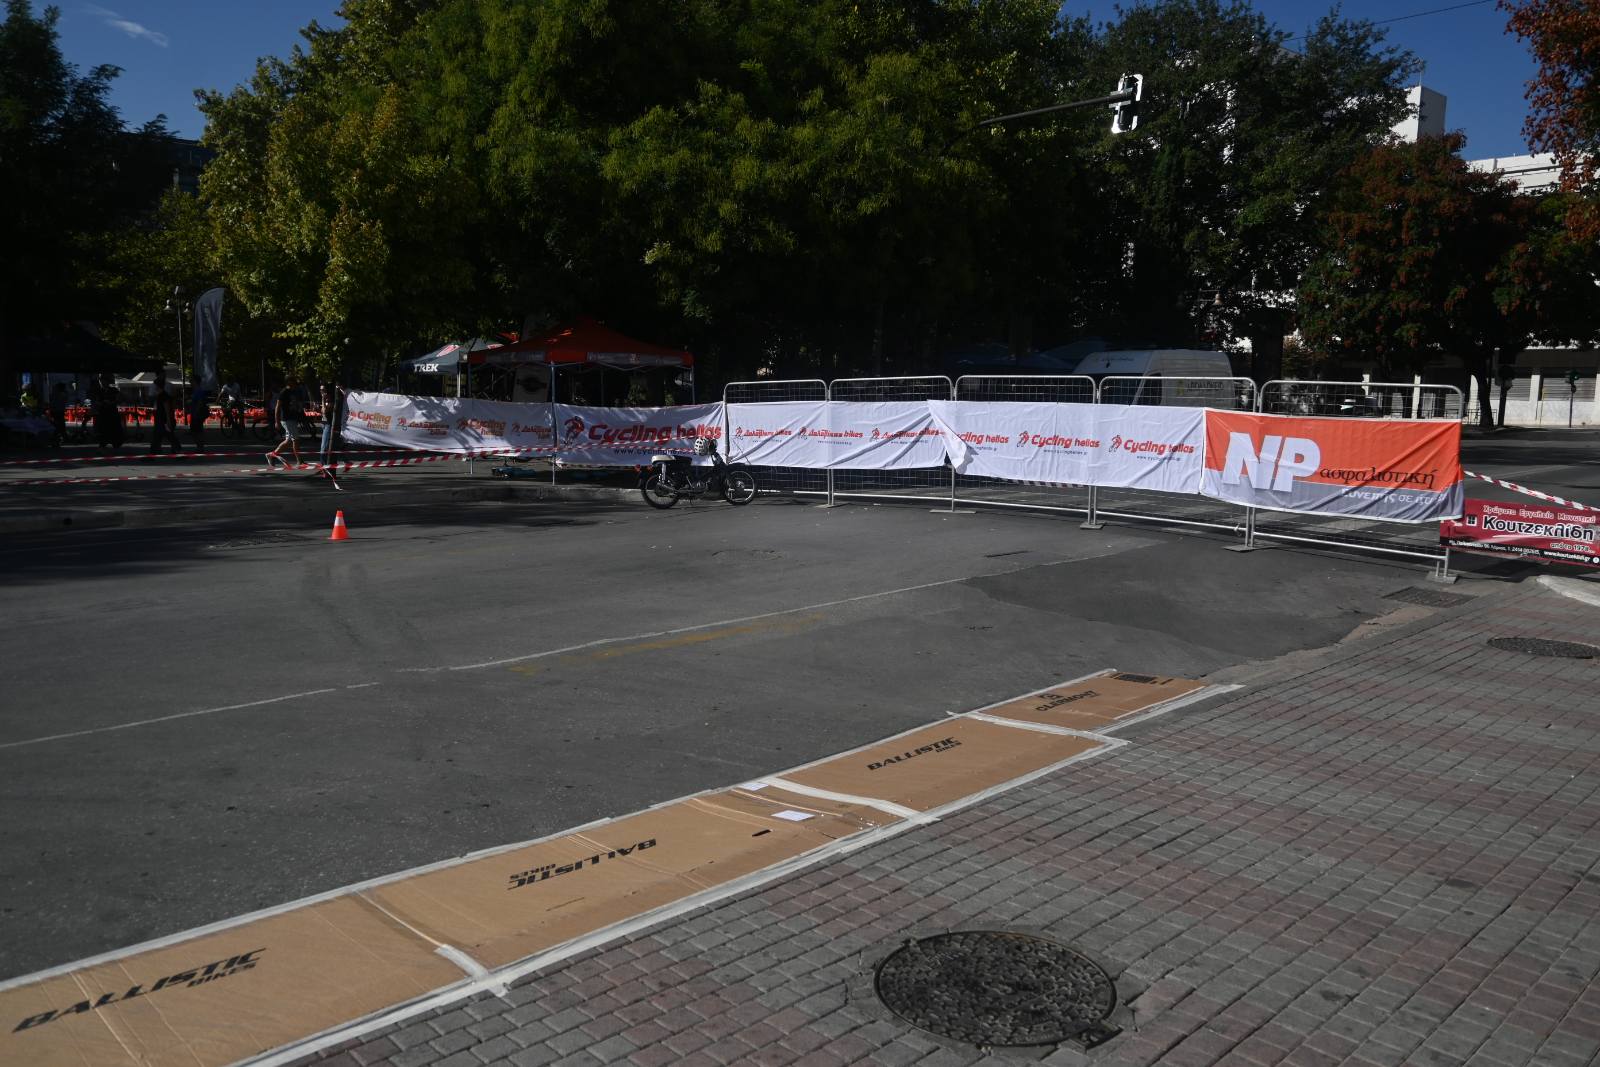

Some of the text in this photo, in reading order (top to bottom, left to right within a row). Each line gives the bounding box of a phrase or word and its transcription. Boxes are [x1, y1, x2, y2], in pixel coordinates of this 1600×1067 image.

[414, 363, 439, 373] TREK
[358, 411, 392, 424] Cycling
[588, 424, 722, 445] Cycling hellas
[986, 434, 1009, 444] hellas
[1031, 434, 1100, 449] Cycling hellas
[1124, 439, 1166, 456] Cycling
[1222, 431, 1320, 493] NP
[1319, 468, 1437, 490] ασφαλιστική
[1483, 515, 1594, 541] Κουτζεκλίδη
[1035, 690, 1100, 712] CLERMONT
[867, 737, 955, 770] BALLISTIC
[507, 839, 657, 891] BALLISTIC
[186, 963, 256, 988] BIKES
[12, 947, 266, 1033] BALLISTIC
